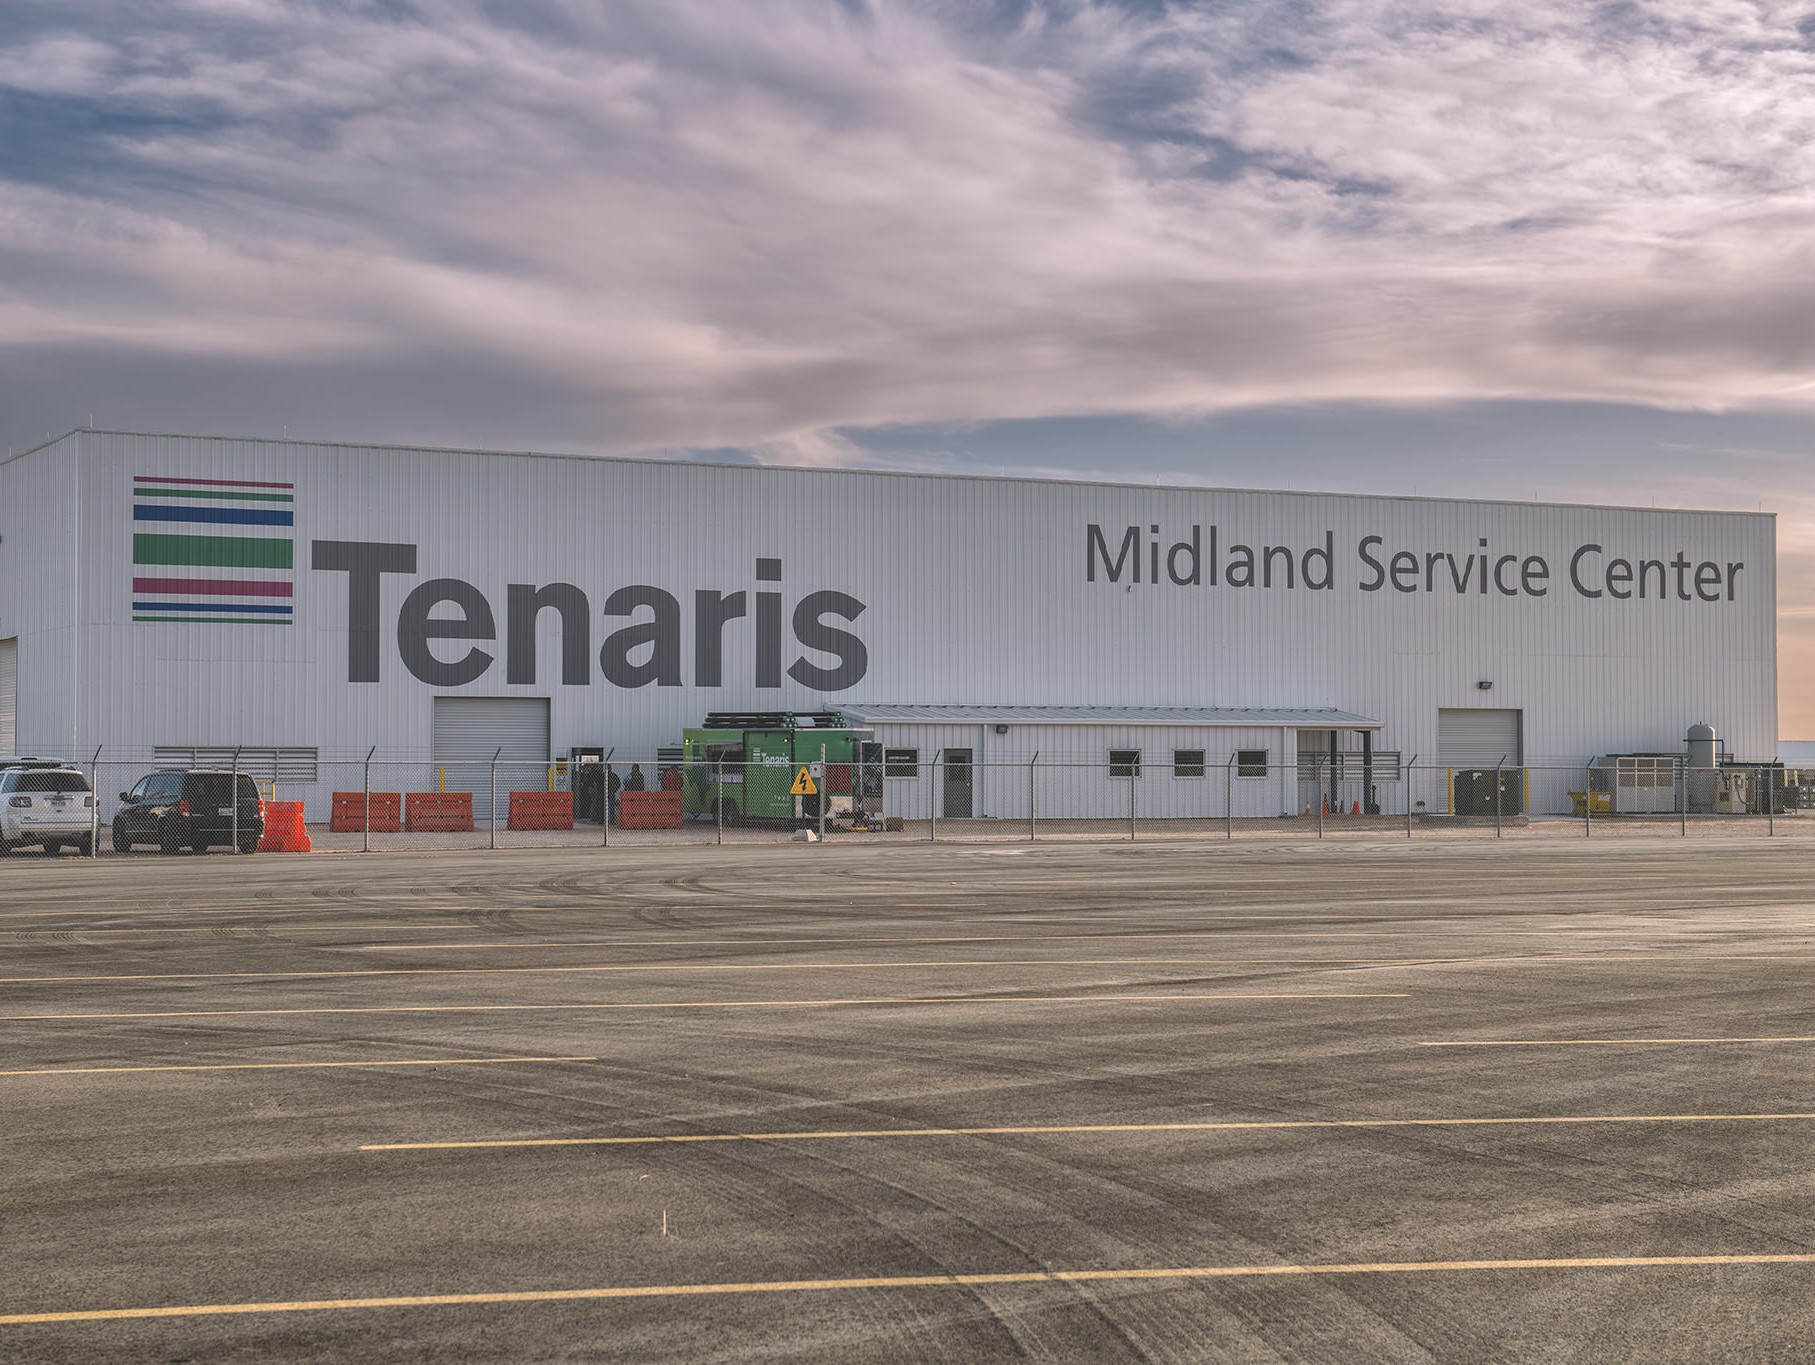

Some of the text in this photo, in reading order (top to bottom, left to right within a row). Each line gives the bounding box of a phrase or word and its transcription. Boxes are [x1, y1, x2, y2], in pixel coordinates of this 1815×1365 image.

[1086, 523, 1745, 602] Midland Service Center
[311, 539, 868, 692] Tenaris
[761, 752, 790, 768] Tenaris
